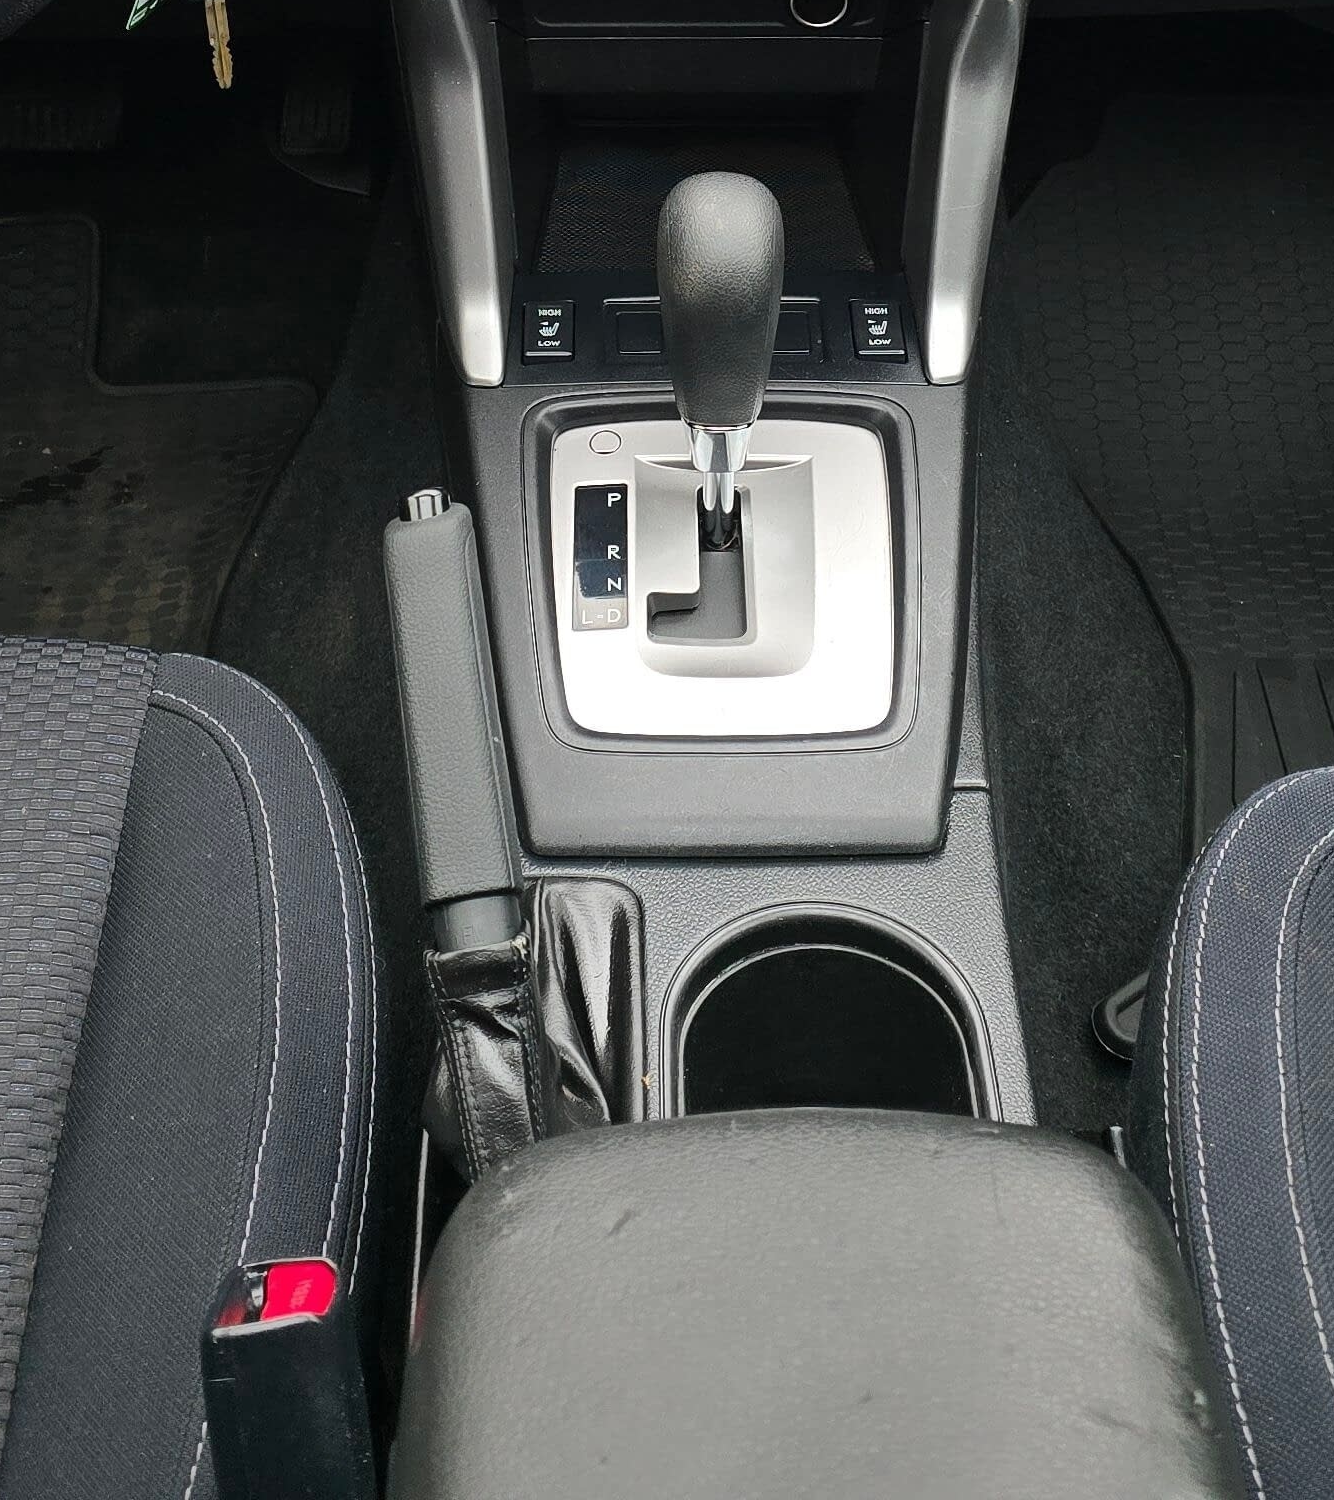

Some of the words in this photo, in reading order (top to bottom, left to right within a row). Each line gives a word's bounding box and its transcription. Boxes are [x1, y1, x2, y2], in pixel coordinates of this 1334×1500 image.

[538, 308, 562, 317] HIGH
[864, 307, 888, 315] HIGH
[537, 339, 561, 347] LOW
[868, 338, 892, 346] LOW
[607, 492, 622, 508] P
[607, 544, 622, 560] R
[607, 577, 622, 592] N
